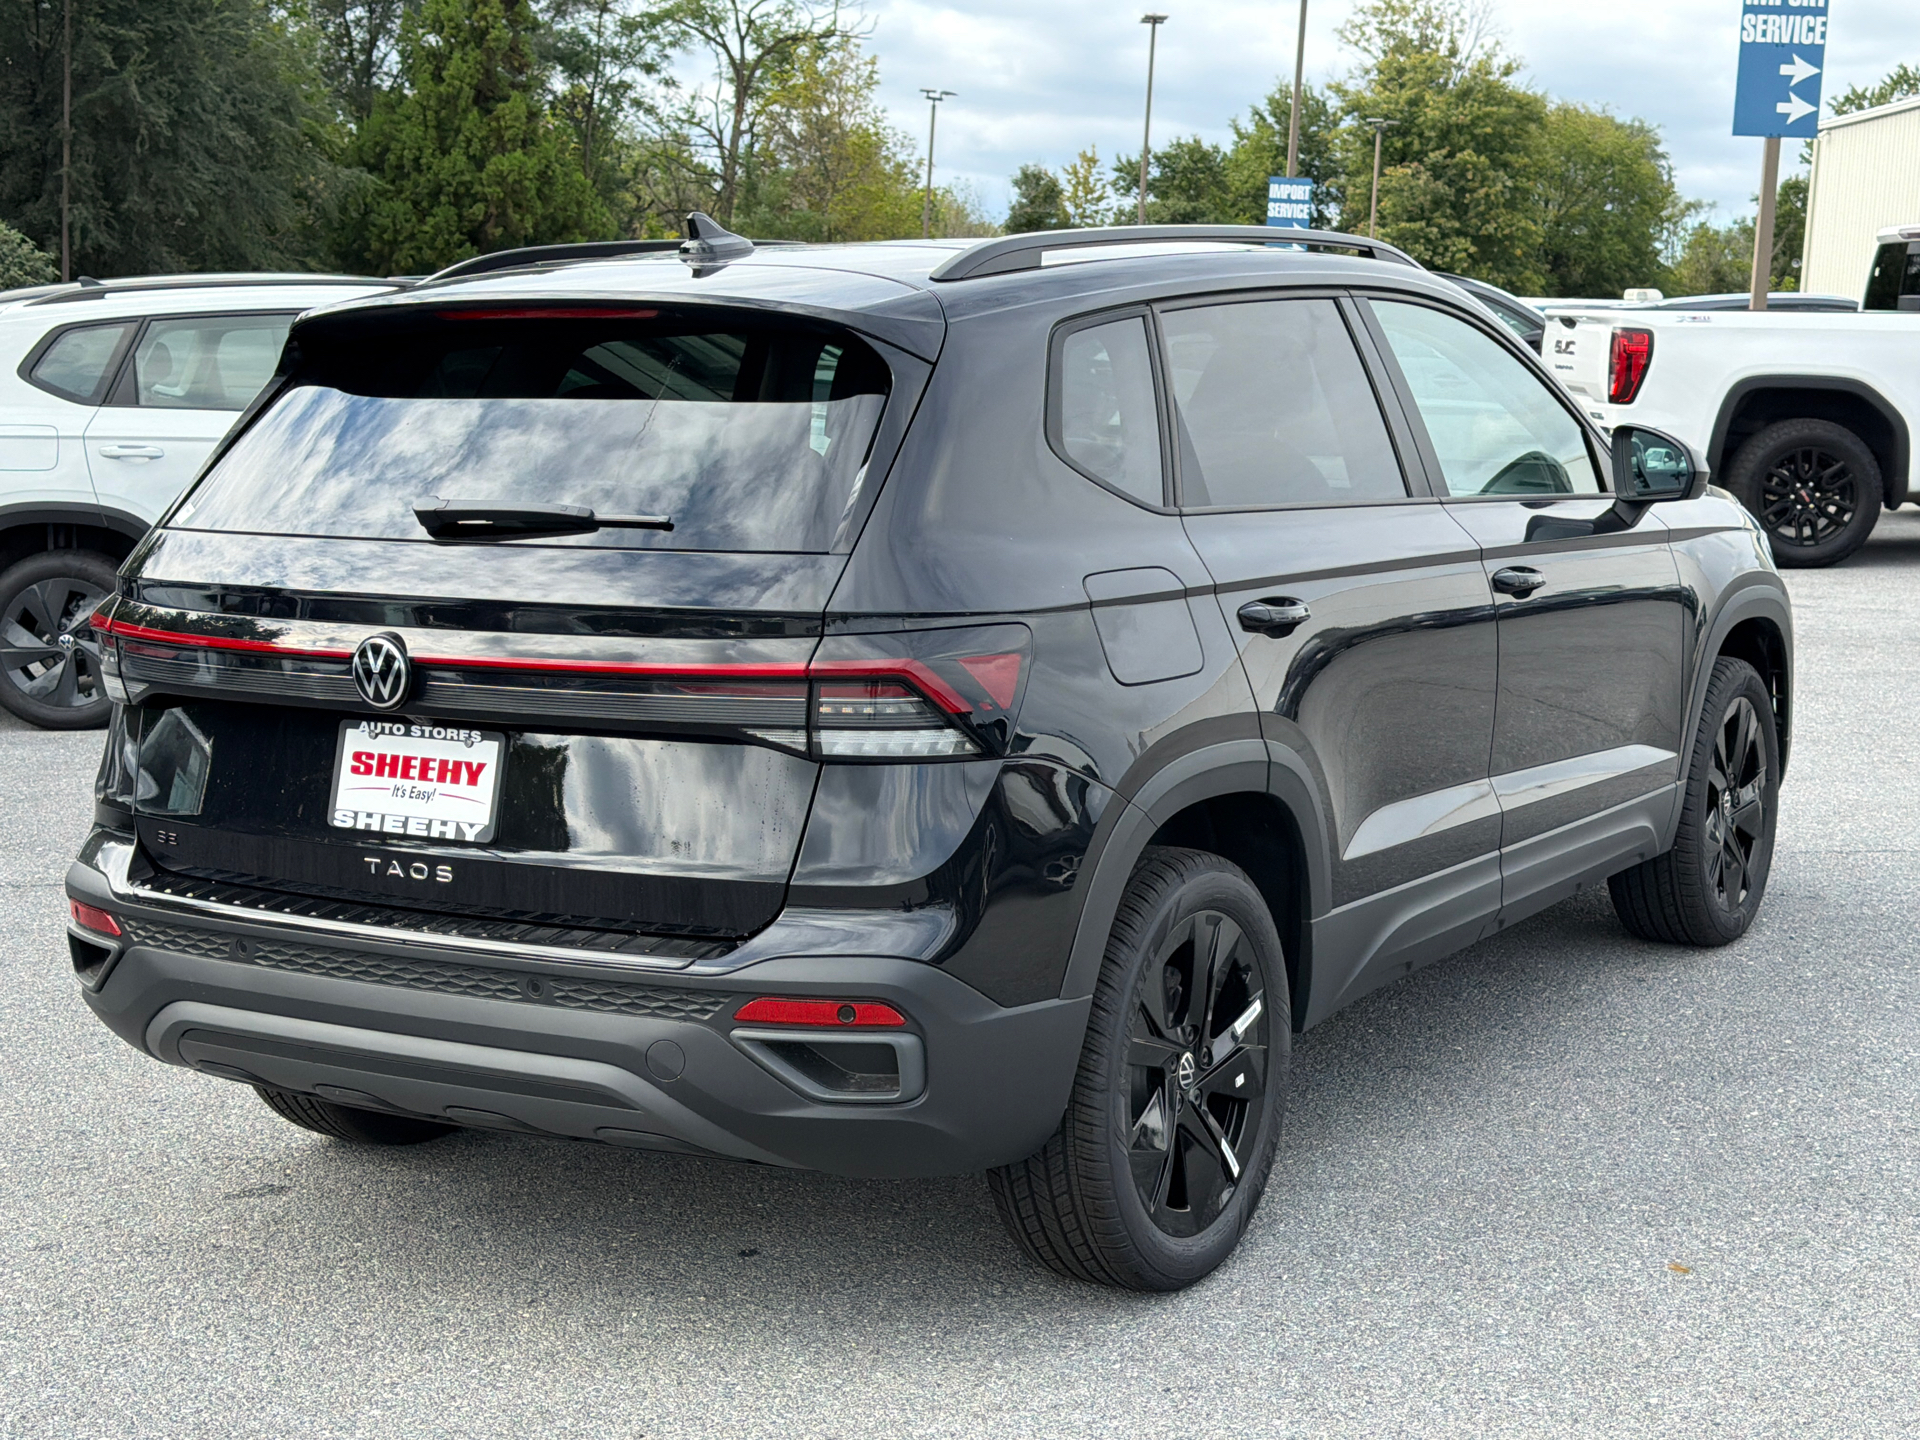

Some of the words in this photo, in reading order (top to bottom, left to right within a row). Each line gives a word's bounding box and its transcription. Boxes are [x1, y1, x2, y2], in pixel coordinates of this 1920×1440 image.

[1741, 13, 1827, 45] SERVICE
[1269, 183, 1312, 200] IMPORT
[1267, 202, 1310, 219] SERVICE
[359, 721, 405, 736] AUTO
[410, 725, 482, 743] STORES
[350, 751, 488, 787] SHEEHY
[391, 784, 407, 798] It's
[408, 786, 437, 804] Easy!
[333, 809, 487, 842] SHEEHY
[364, 857, 453, 883] TAOS
